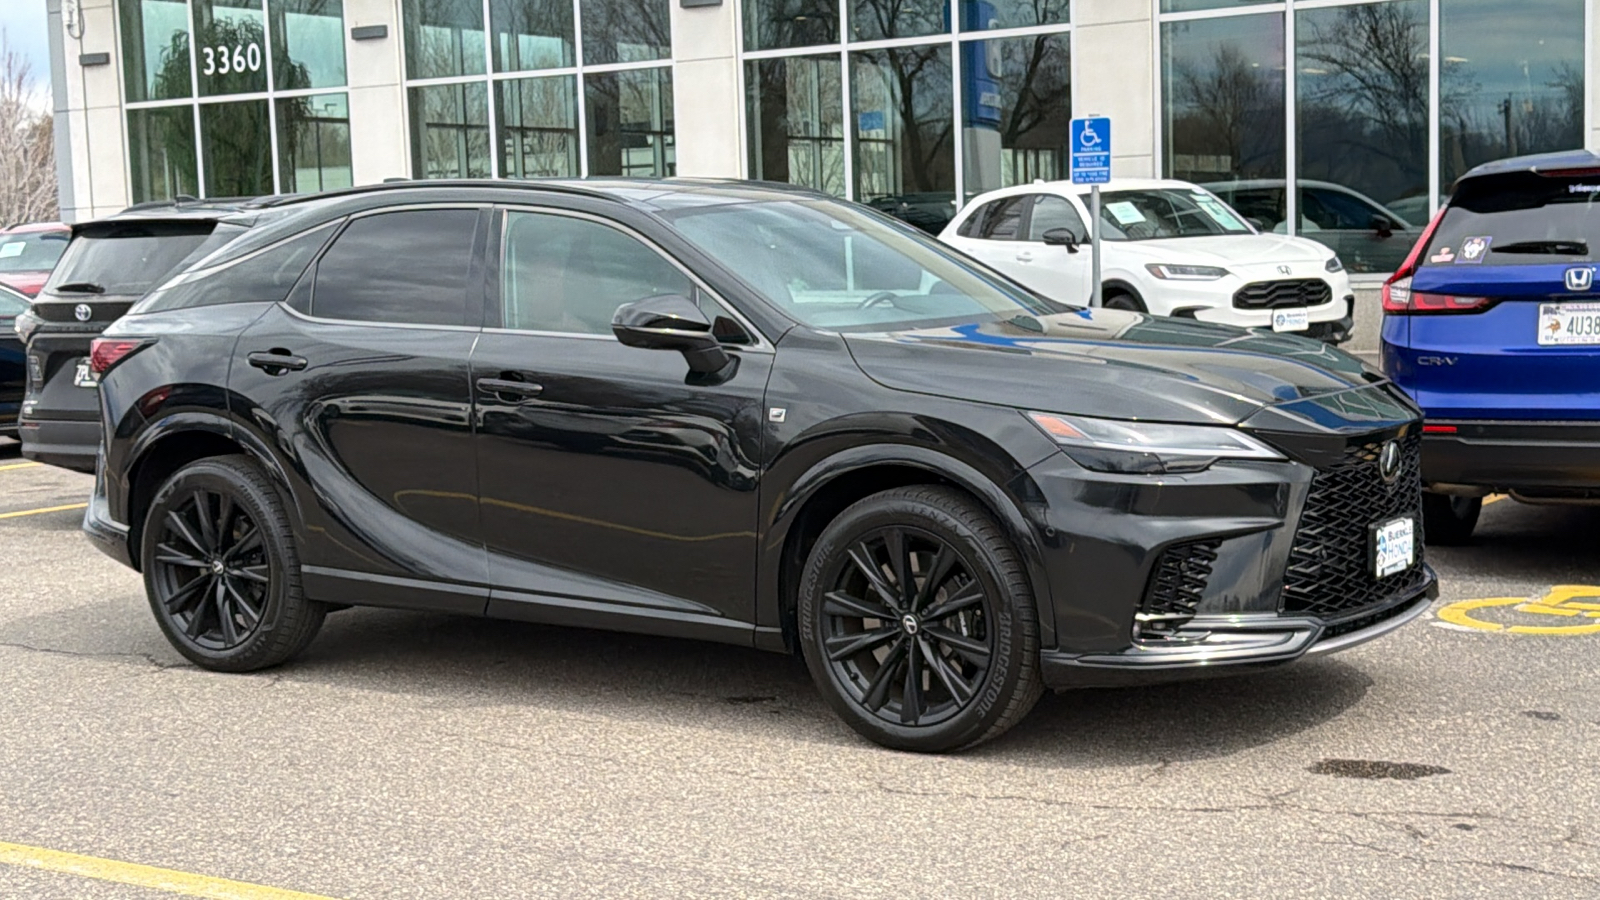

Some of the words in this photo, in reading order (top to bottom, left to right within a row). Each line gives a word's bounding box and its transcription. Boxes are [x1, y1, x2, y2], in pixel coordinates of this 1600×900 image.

[202, 42, 261, 75] 3360
[1417, 356, 1459, 366] CR-V
[1387, 539, 1412, 561] HONDA
[975, 612, 1012, 718] BRIDGESTONE
